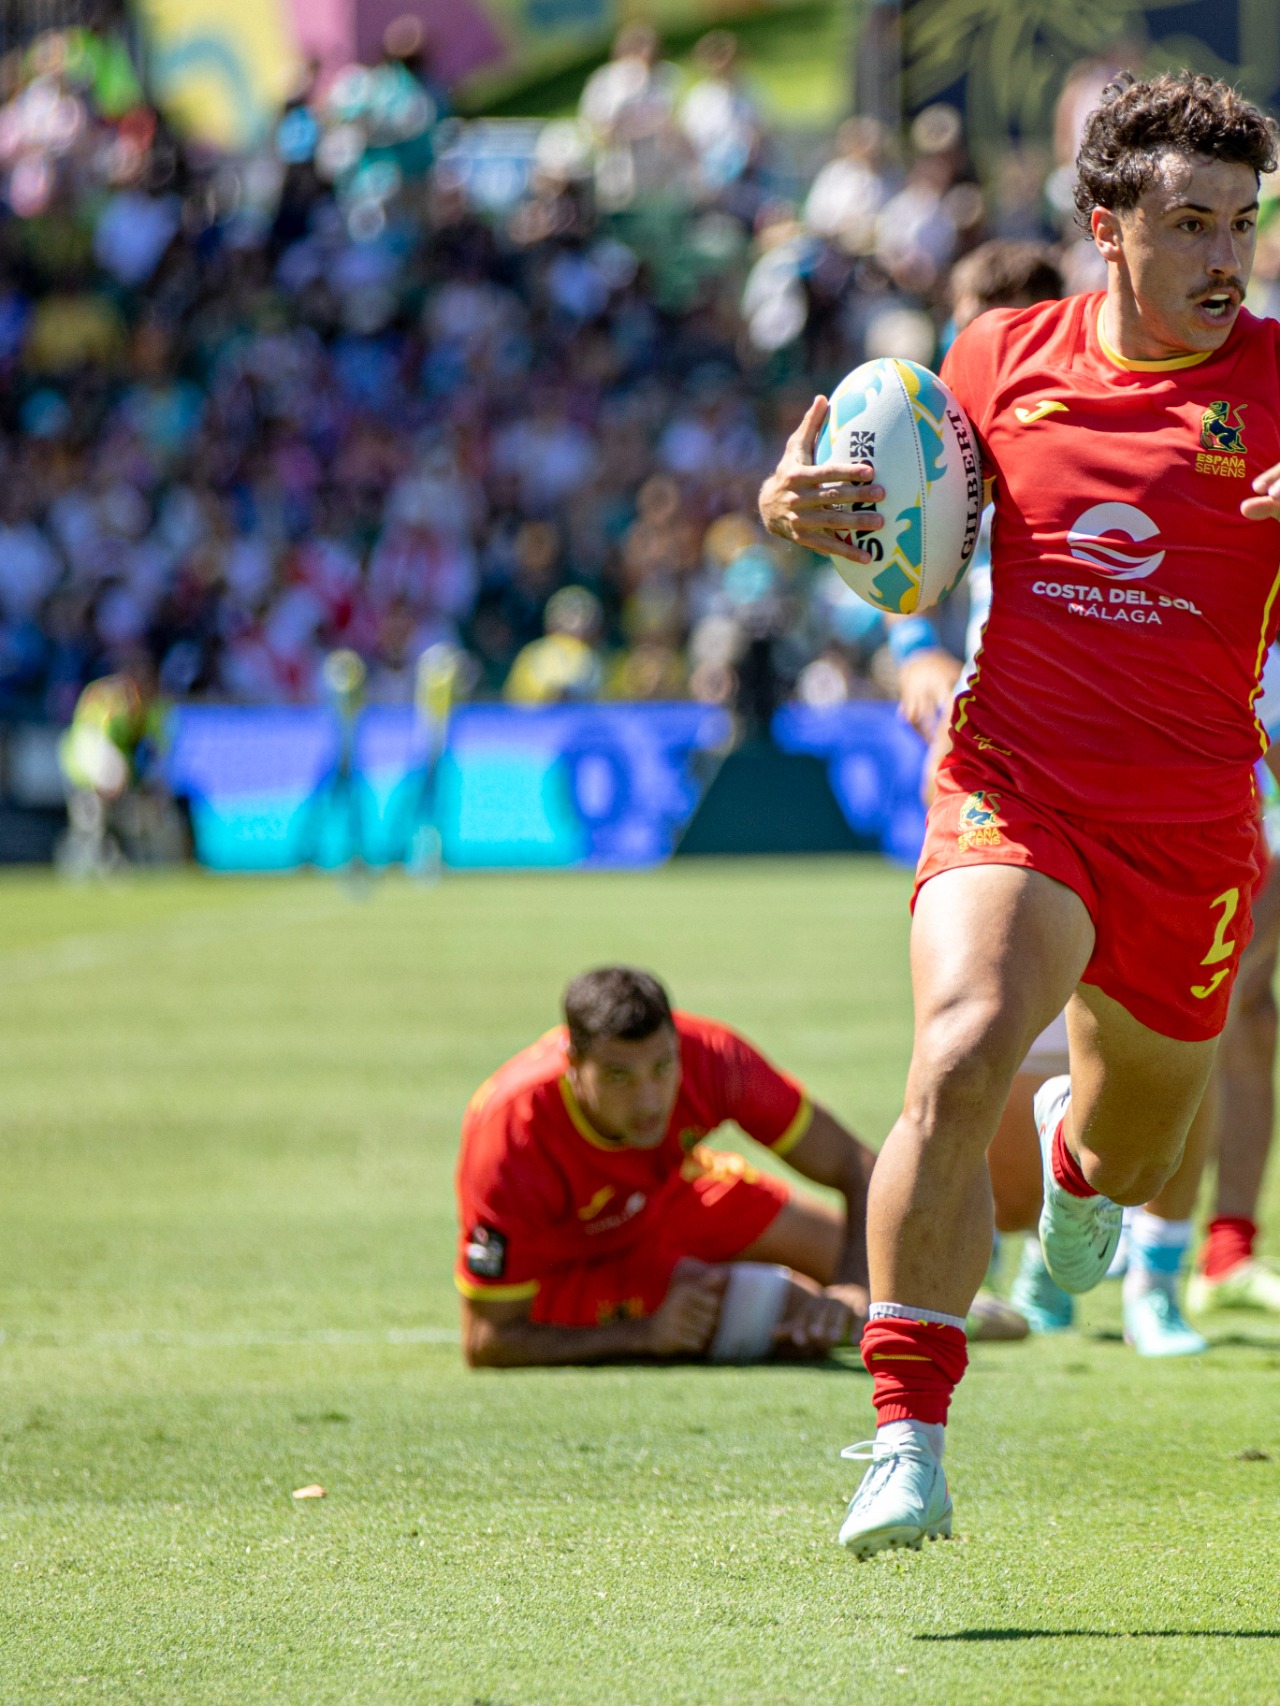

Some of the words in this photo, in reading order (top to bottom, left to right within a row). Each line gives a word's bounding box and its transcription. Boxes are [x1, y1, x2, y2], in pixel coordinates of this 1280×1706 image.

[1194, 461, 1246, 479] SEVENS
[1196, 452, 1246, 469] ESPAÑA
[946, 408, 979, 560] GILBERT
[1031, 580, 1104, 603] COSTA
[1109, 588, 1154, 606] DEL
[1158, 594, 1203, 616] SOL
[1067, 602, 1163, 625] MÁLAGA
[1199, 887, 1240, 966] 2
